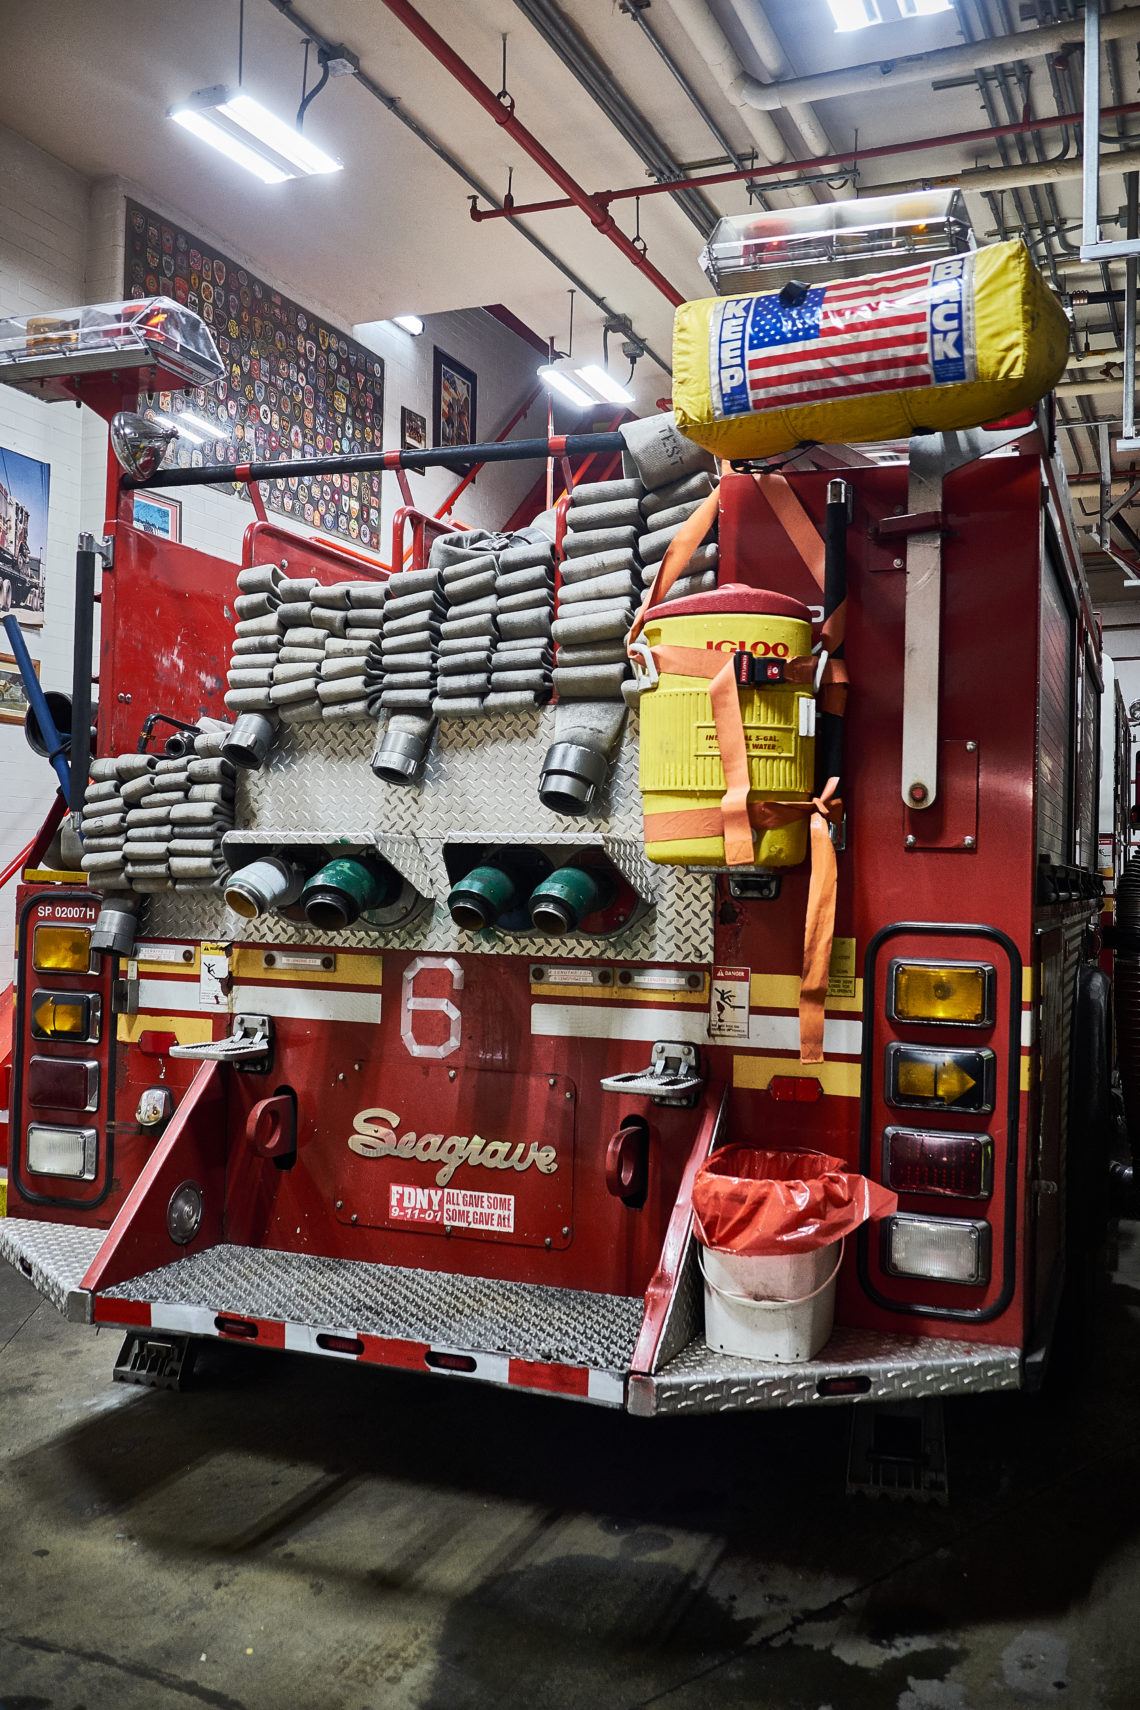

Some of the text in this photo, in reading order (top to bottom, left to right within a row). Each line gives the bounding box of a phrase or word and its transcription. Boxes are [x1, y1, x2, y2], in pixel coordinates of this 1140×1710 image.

[931, 260, 963, 361] BACK
[720, 299, 751, 394] KEEP
[658, 424, 684, 466] TEST
[55, 906, 95, 919] 02007H
[400, 956, 464, 1059] 6
[348, 1107, 558, 1187] Seagrave
[390, 1185, 443, 1210] FDNY
[391, 1206, 442, 1221] 9-11-01
[445, 1191, 512, 1211] ALL GAVE SOME
[445, 1208, 512, 1228] SOME GAVE ALL
